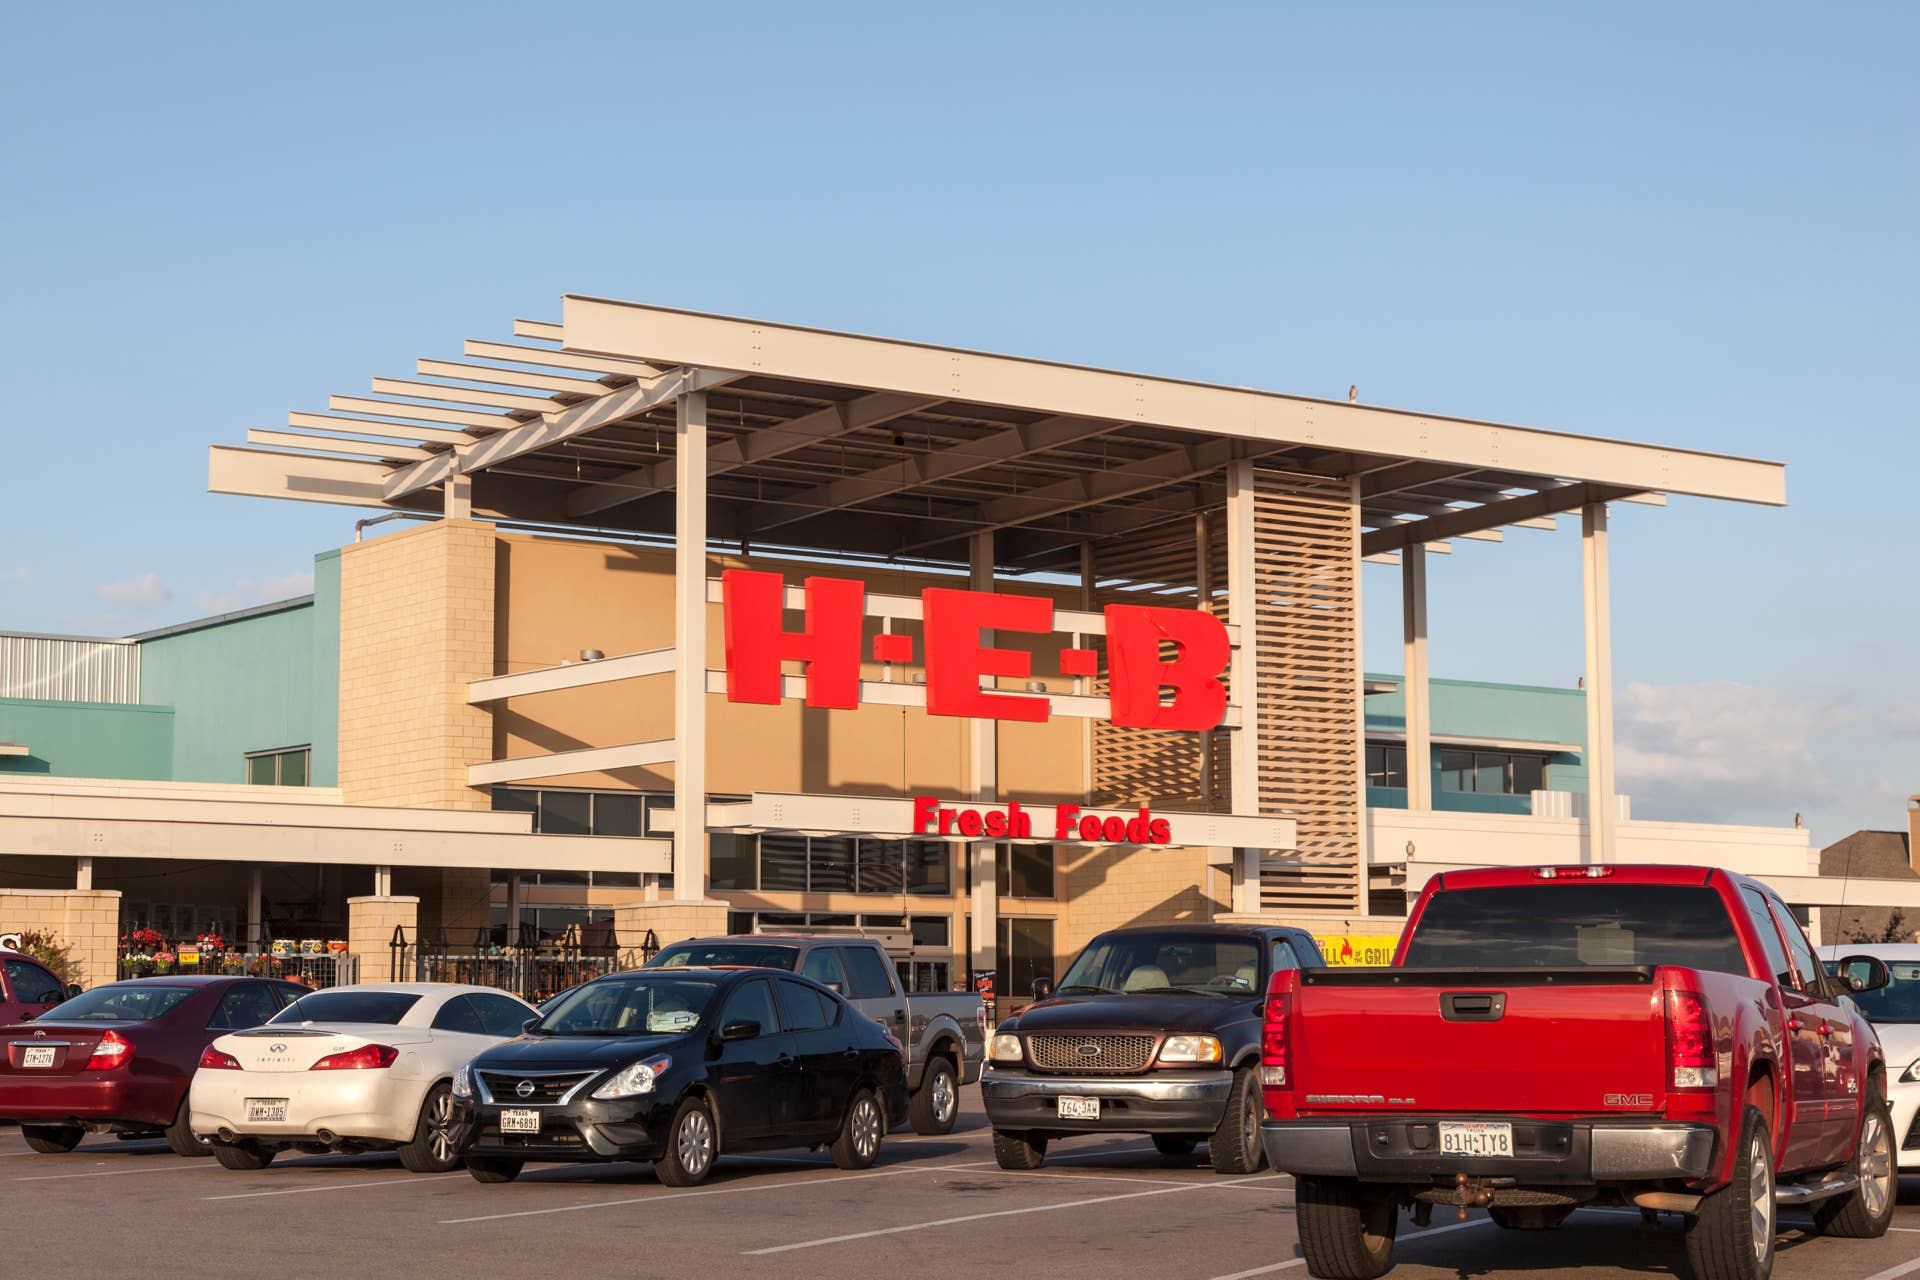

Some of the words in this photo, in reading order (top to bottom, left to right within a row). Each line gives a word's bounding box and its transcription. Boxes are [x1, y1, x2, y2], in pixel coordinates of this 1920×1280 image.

[914, 797, 1031, 838] Fresh
[1056, 804, 1172, 844] Foods
[1604, 1093, 1653, 1106] GMC
